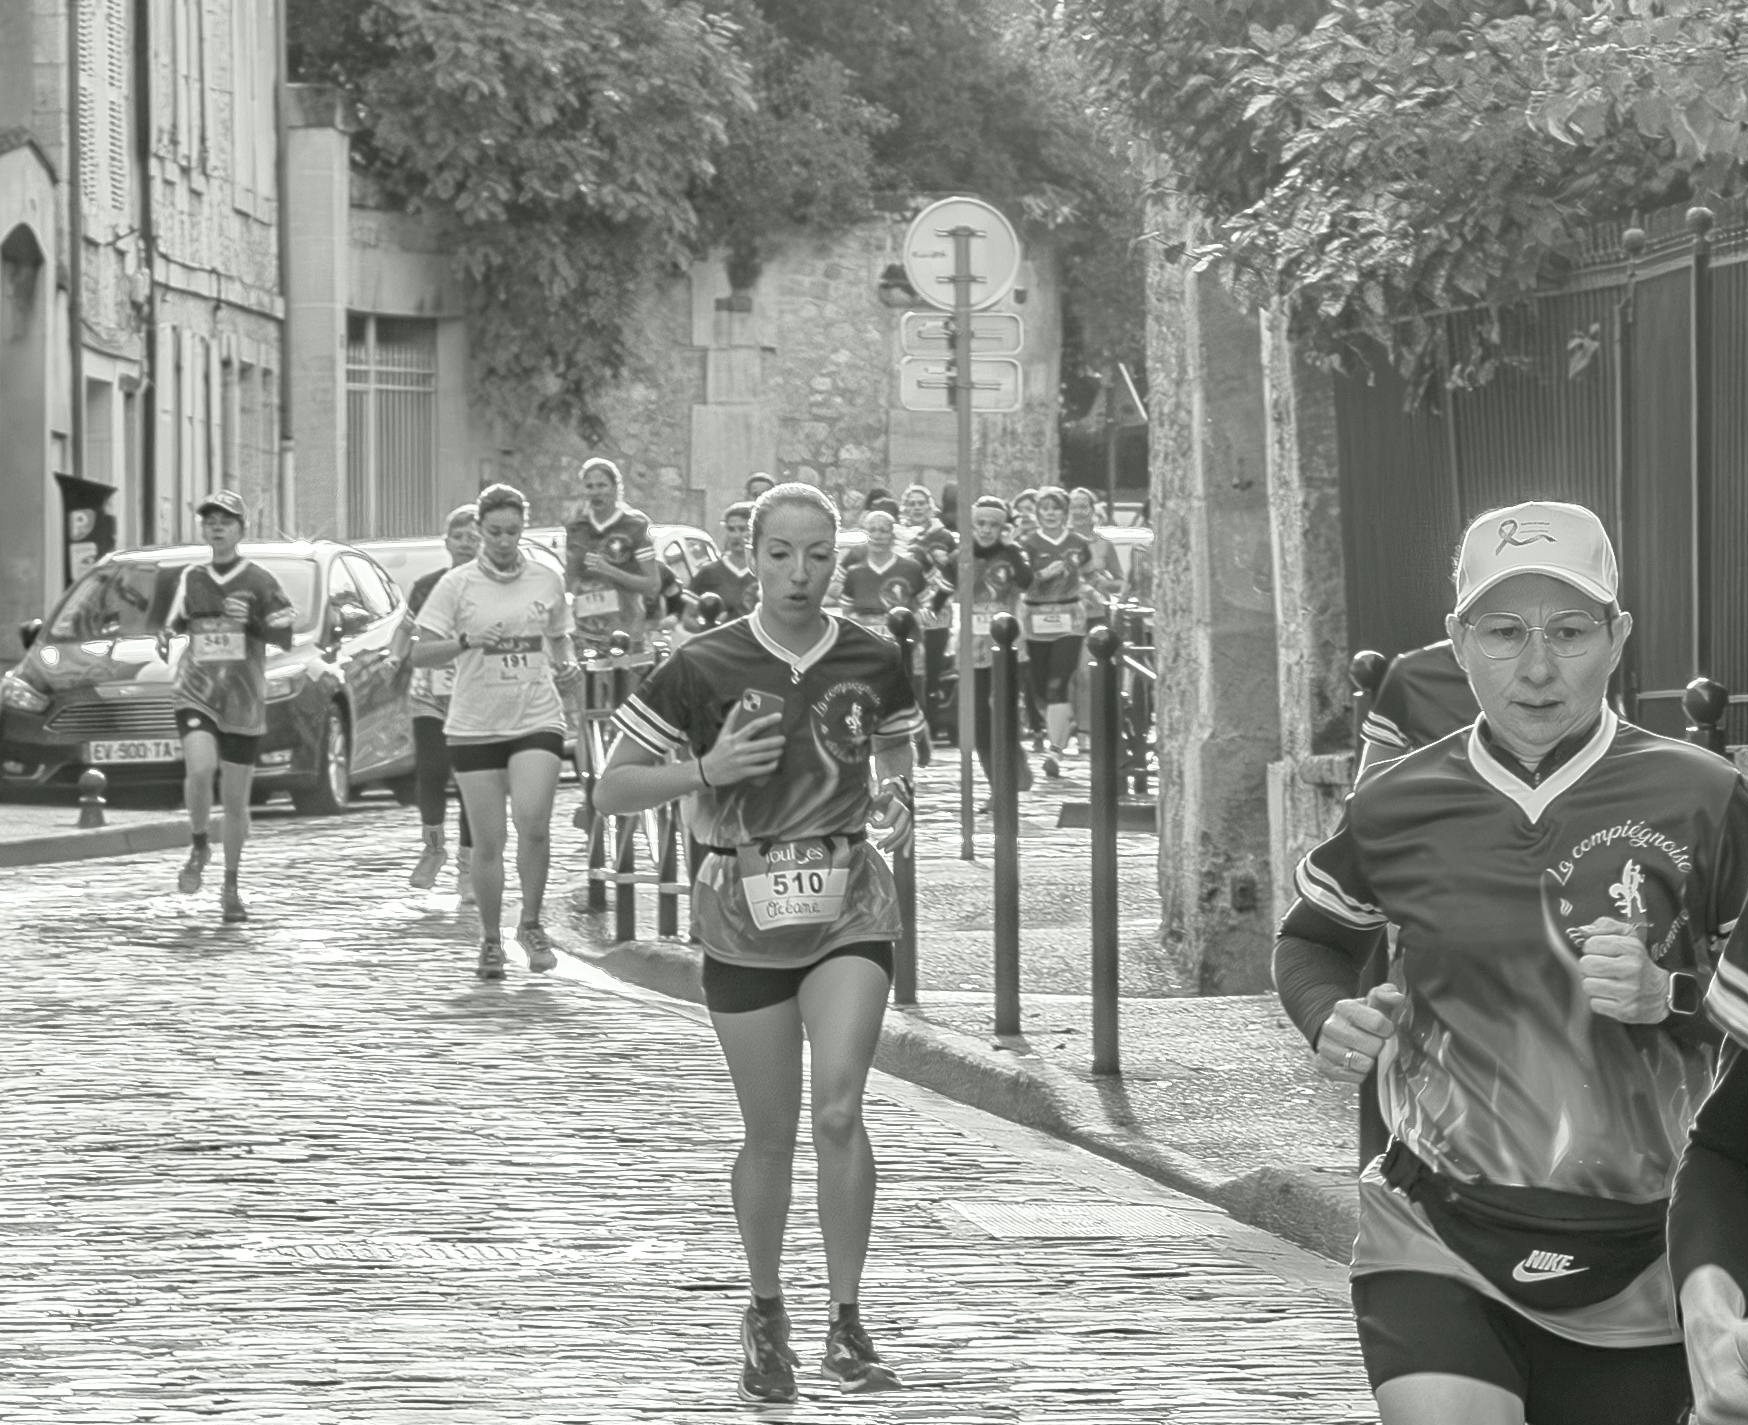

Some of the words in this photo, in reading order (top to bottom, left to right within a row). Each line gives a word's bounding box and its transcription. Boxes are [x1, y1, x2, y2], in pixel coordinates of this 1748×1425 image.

[502, 654, 528, 668] 191
[773, 871, 823, 895] 510
[1546, 859, 1574, 886] La
[1524, 1249, 1575, 1273] NIKE
